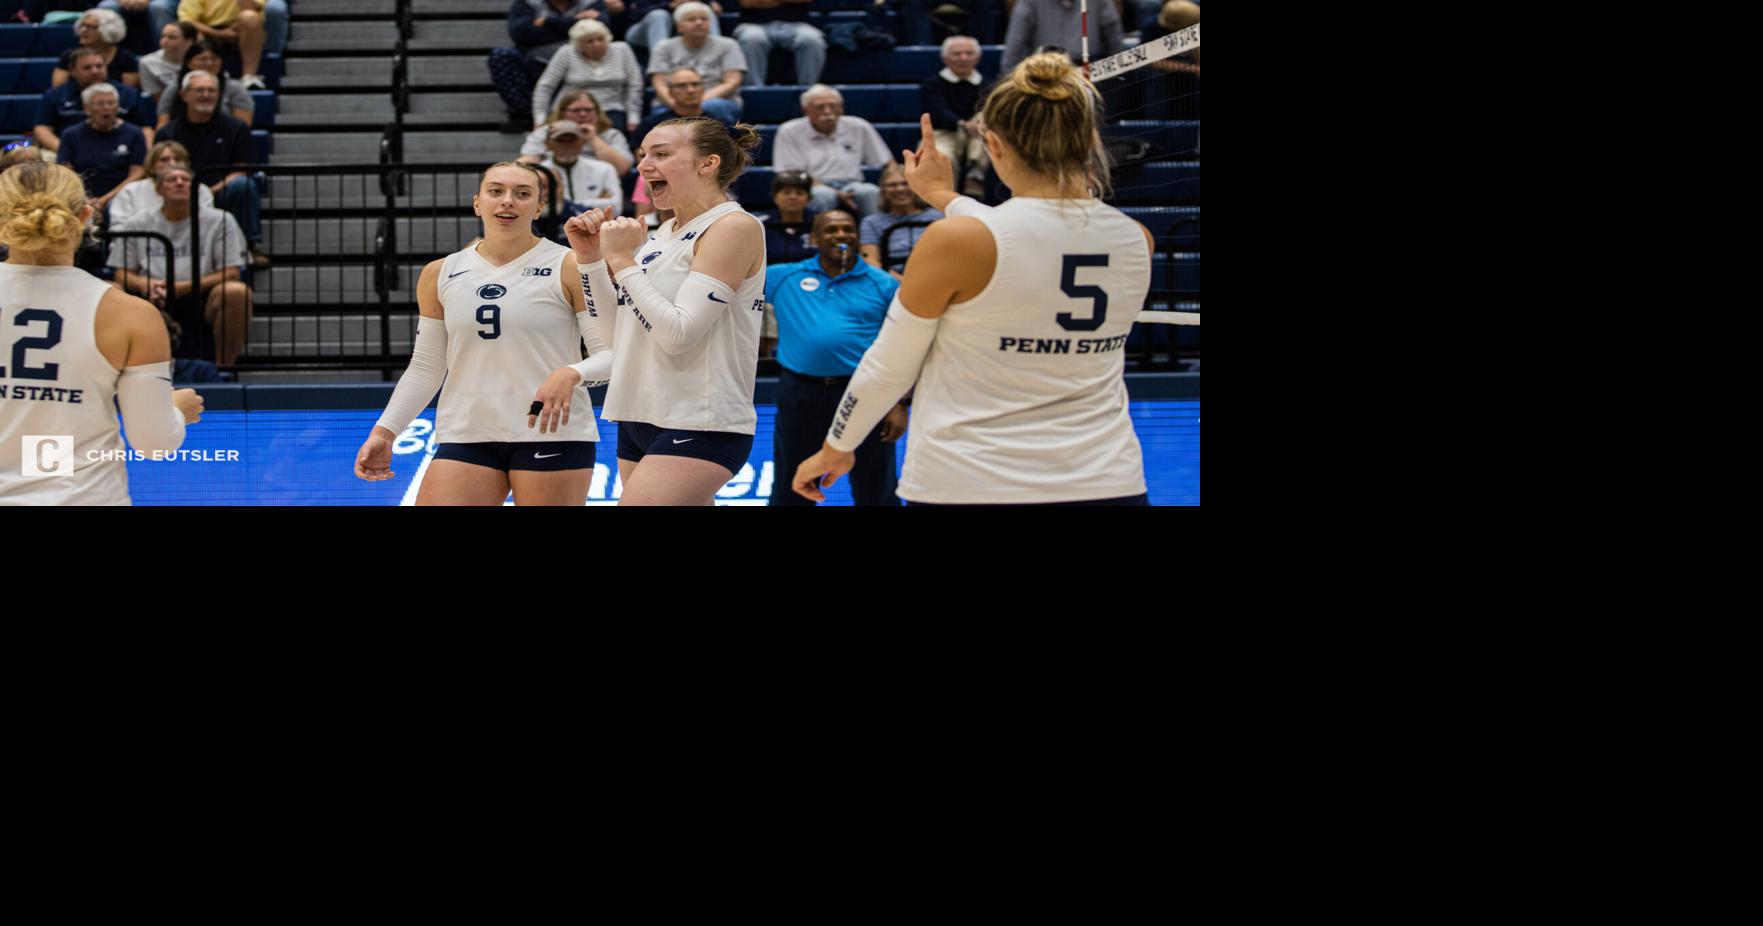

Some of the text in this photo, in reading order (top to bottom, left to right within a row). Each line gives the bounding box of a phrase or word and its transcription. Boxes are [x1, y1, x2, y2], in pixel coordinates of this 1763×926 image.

[1056, 254, 1109, 331] 5
[475, 304, 501, 339] 9
[999, 337, 1071, 354] PENN
[12, 385, 84, 403] STATE
